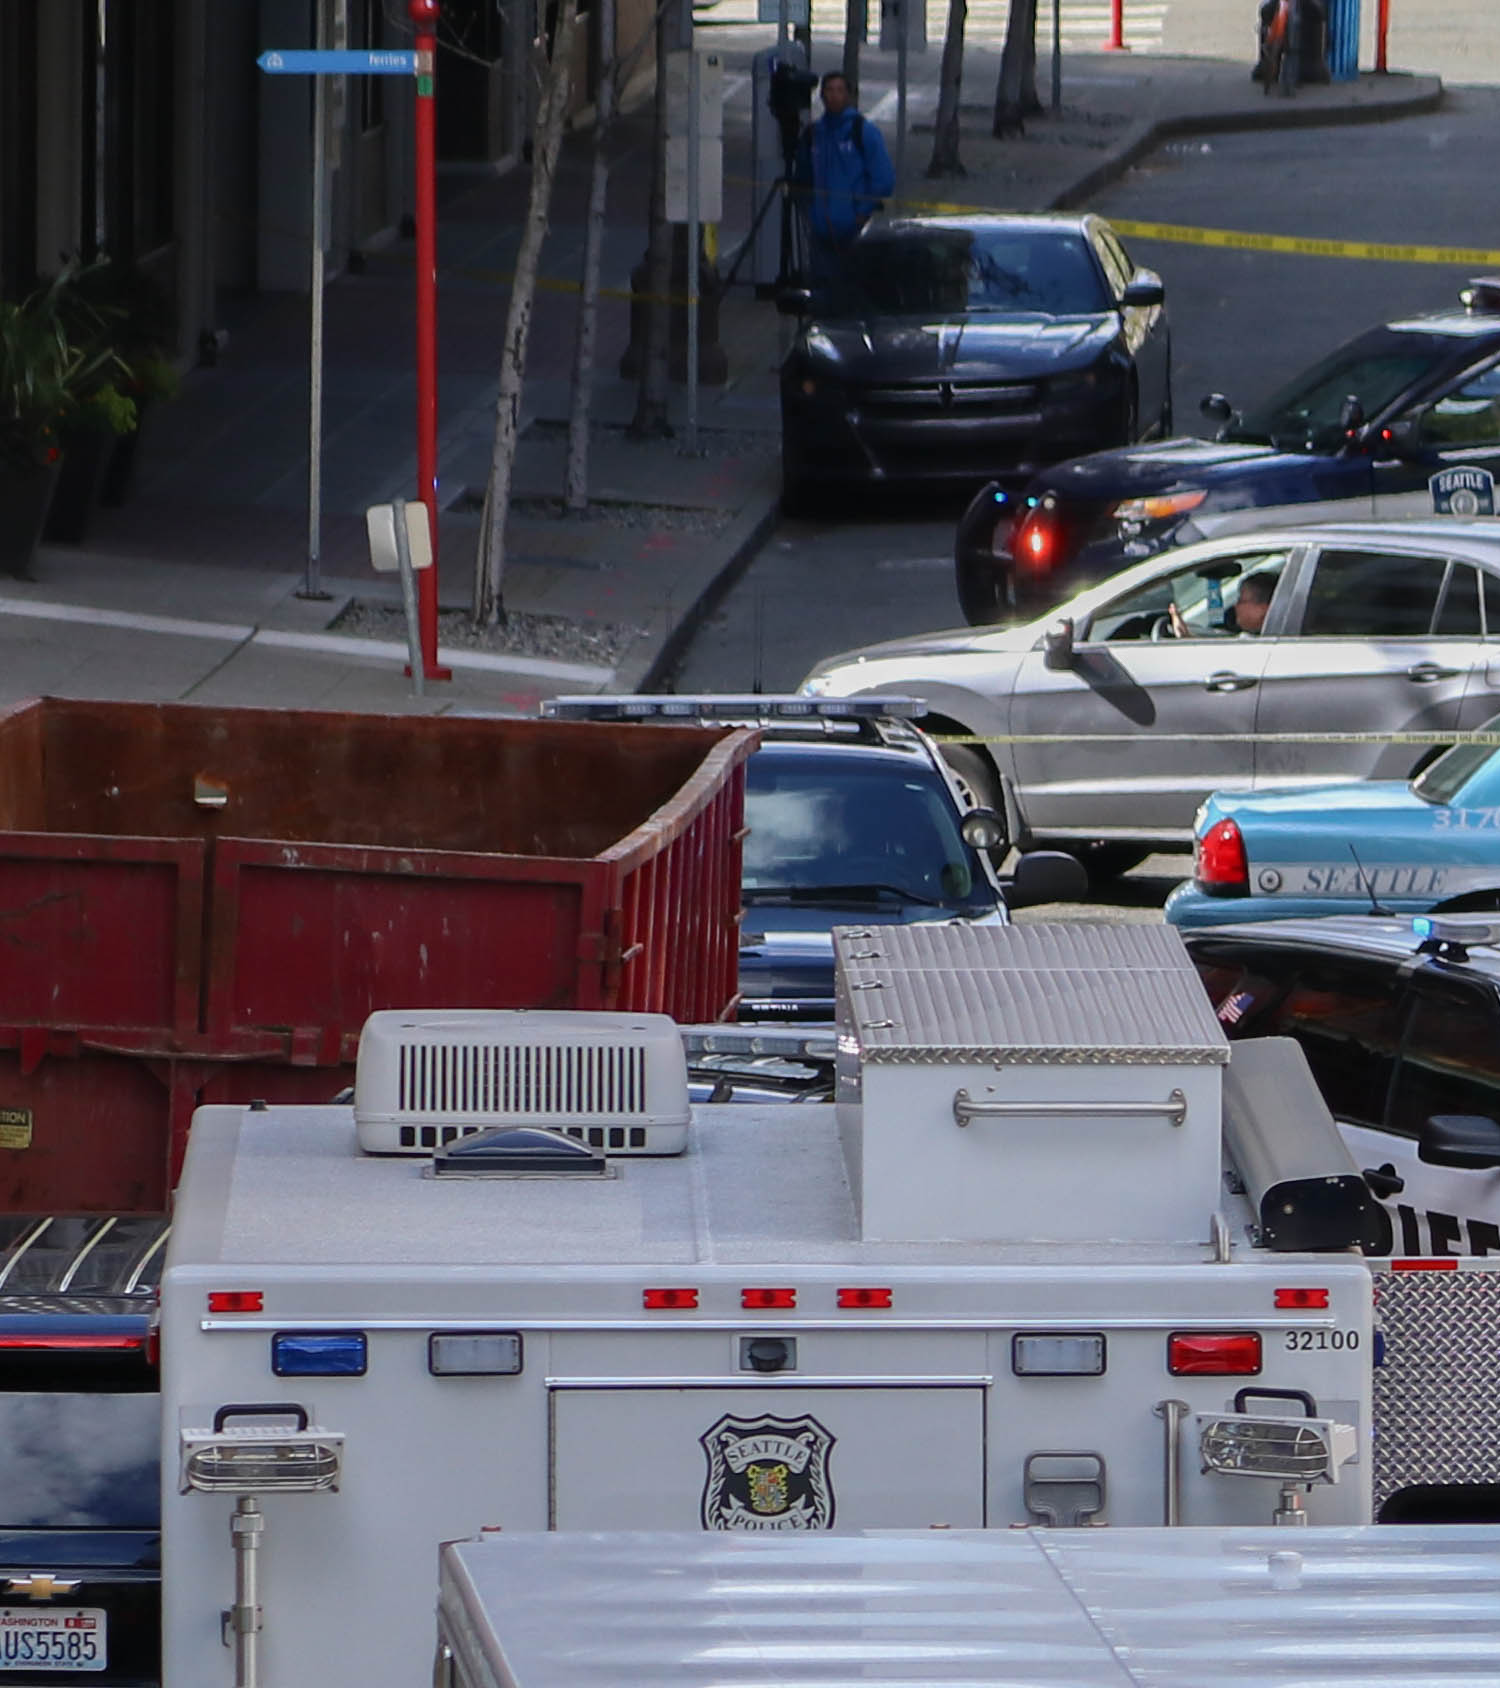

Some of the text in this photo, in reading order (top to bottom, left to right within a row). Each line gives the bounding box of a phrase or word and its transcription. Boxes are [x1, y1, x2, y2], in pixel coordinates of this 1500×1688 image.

[368, 53, 406, 66] ferries
[1438, 475, 1484, 490] SEATTLE
[1303, 867, 1449, 894] SEATTLE
[1285, 1331, 1359, 1351] 32100
[727, 1440, 807, 1467] SEATTLE
[733, 1513, 804, 1530] POLICE
[0, 1618, 58, 1628] ASHINGTON
[0, 1631, 97, 1661] US5585
